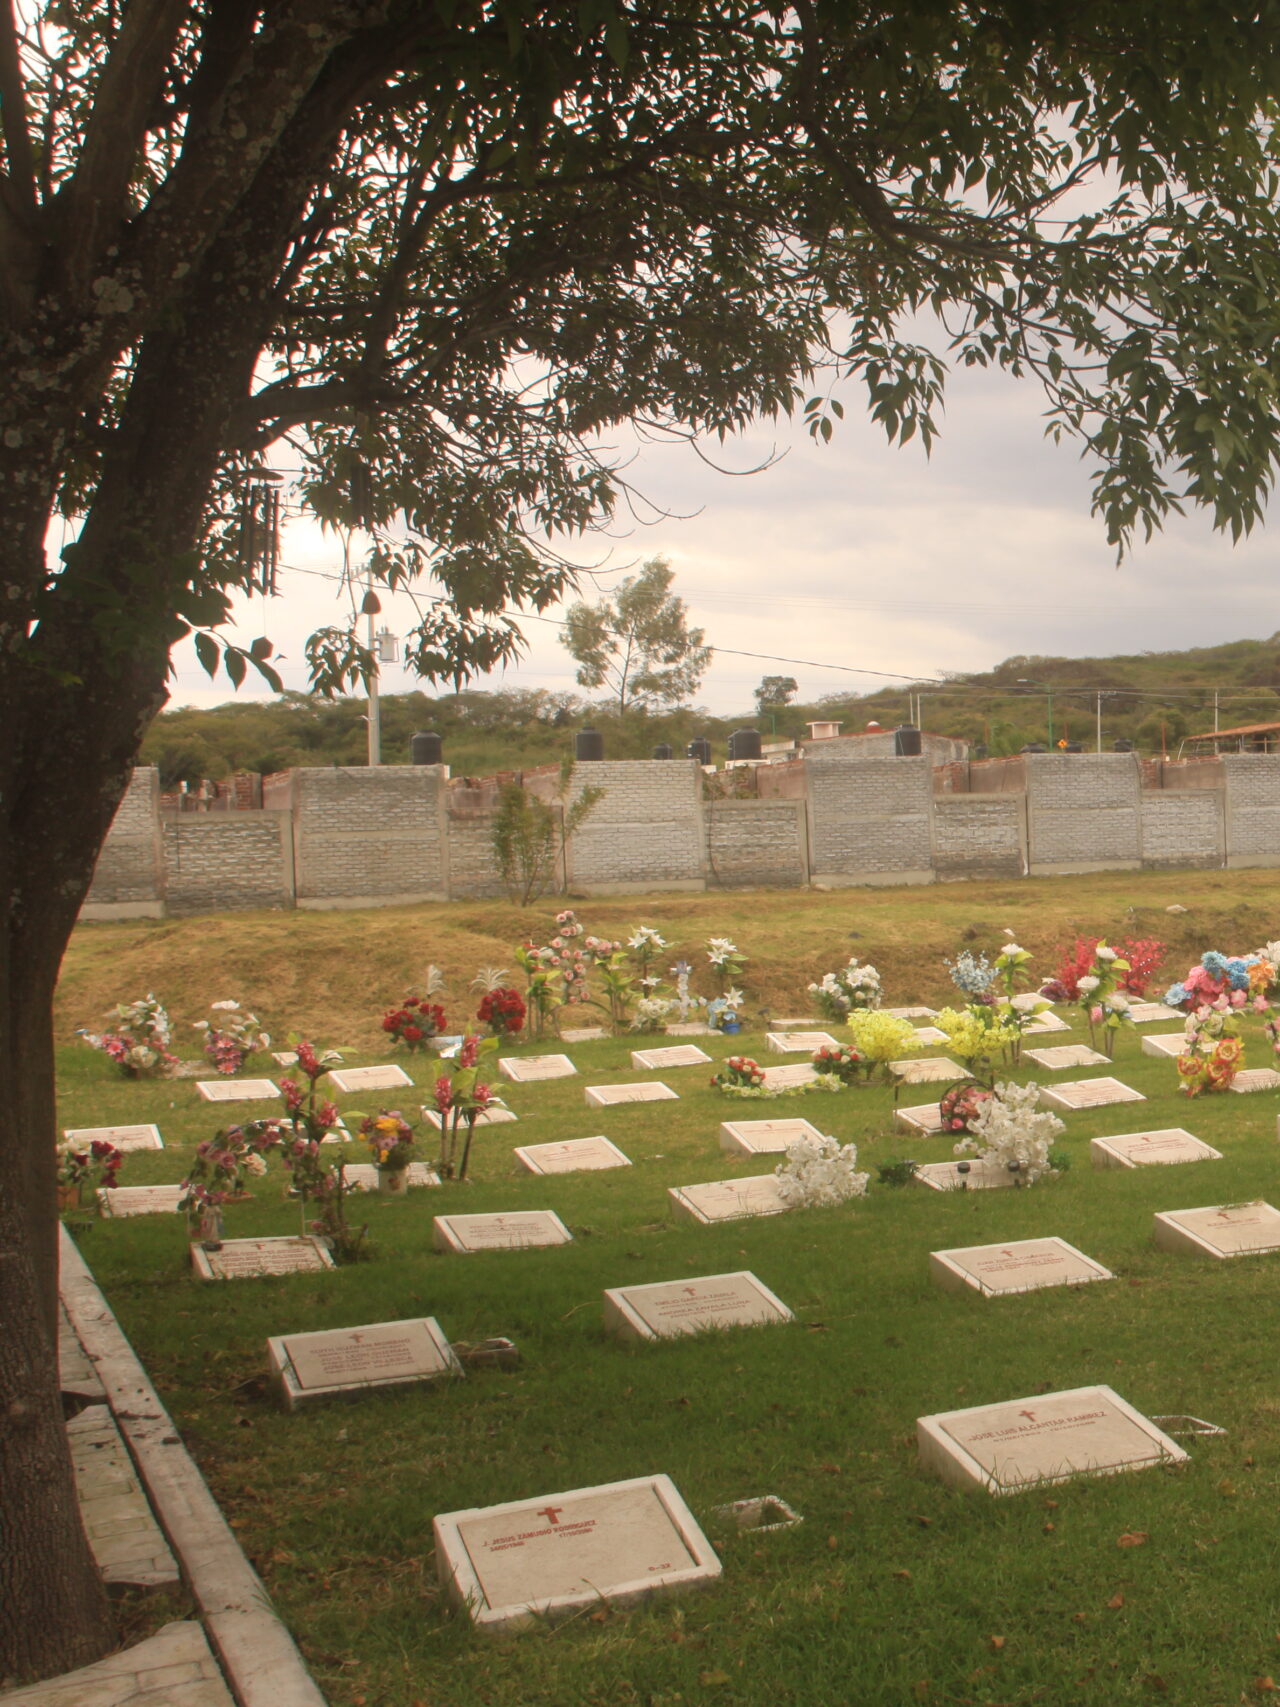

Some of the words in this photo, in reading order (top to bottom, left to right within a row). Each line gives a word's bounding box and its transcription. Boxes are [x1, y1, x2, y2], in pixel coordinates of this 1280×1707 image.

[997, 1428, 1018, 1438] LUIS
[492, 1536, 516, 1546] JESUS
[518, 1528, 553, 1541] ZAMUDIO
[554, 1520, 598, 1534] RODRIGUEZ
